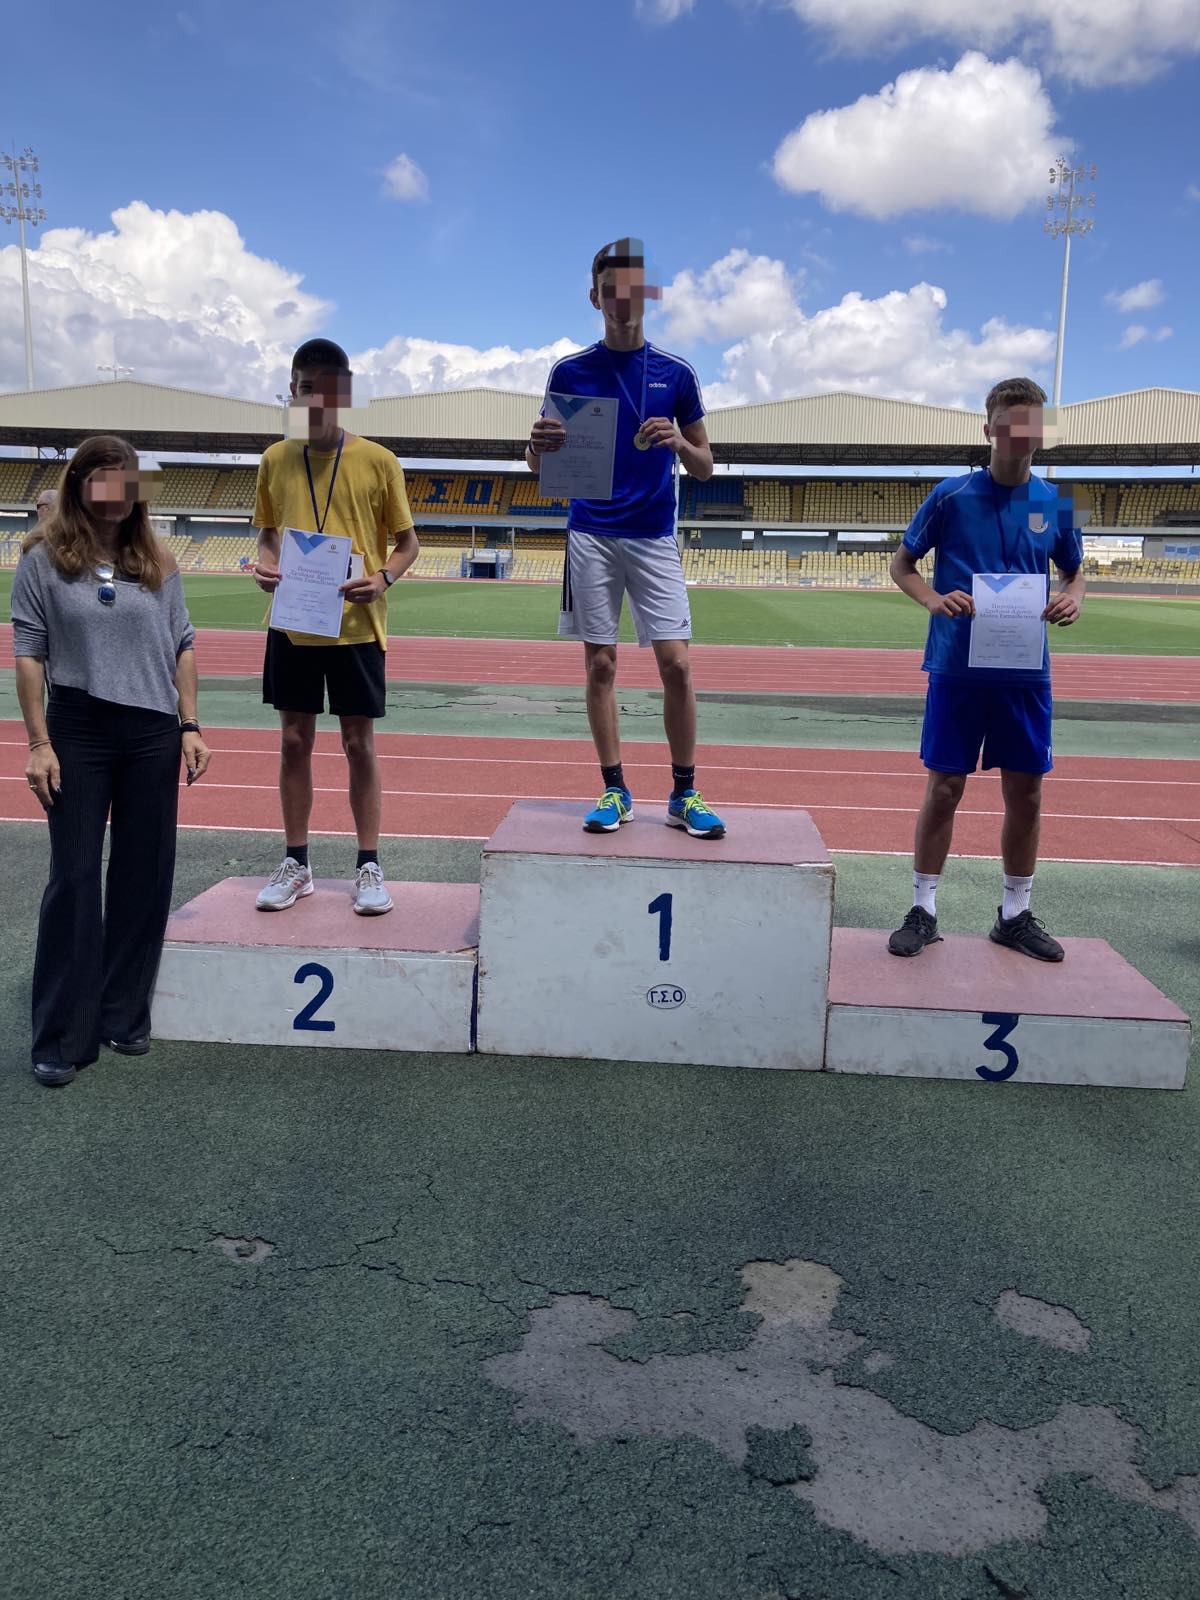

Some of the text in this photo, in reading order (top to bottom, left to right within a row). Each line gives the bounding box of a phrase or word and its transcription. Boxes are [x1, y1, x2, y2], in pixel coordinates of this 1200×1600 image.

[648, 893, 673, 961] 1
[293, 962, 335, 1031] 2
[976, 1012, 1019, 1082] 3
